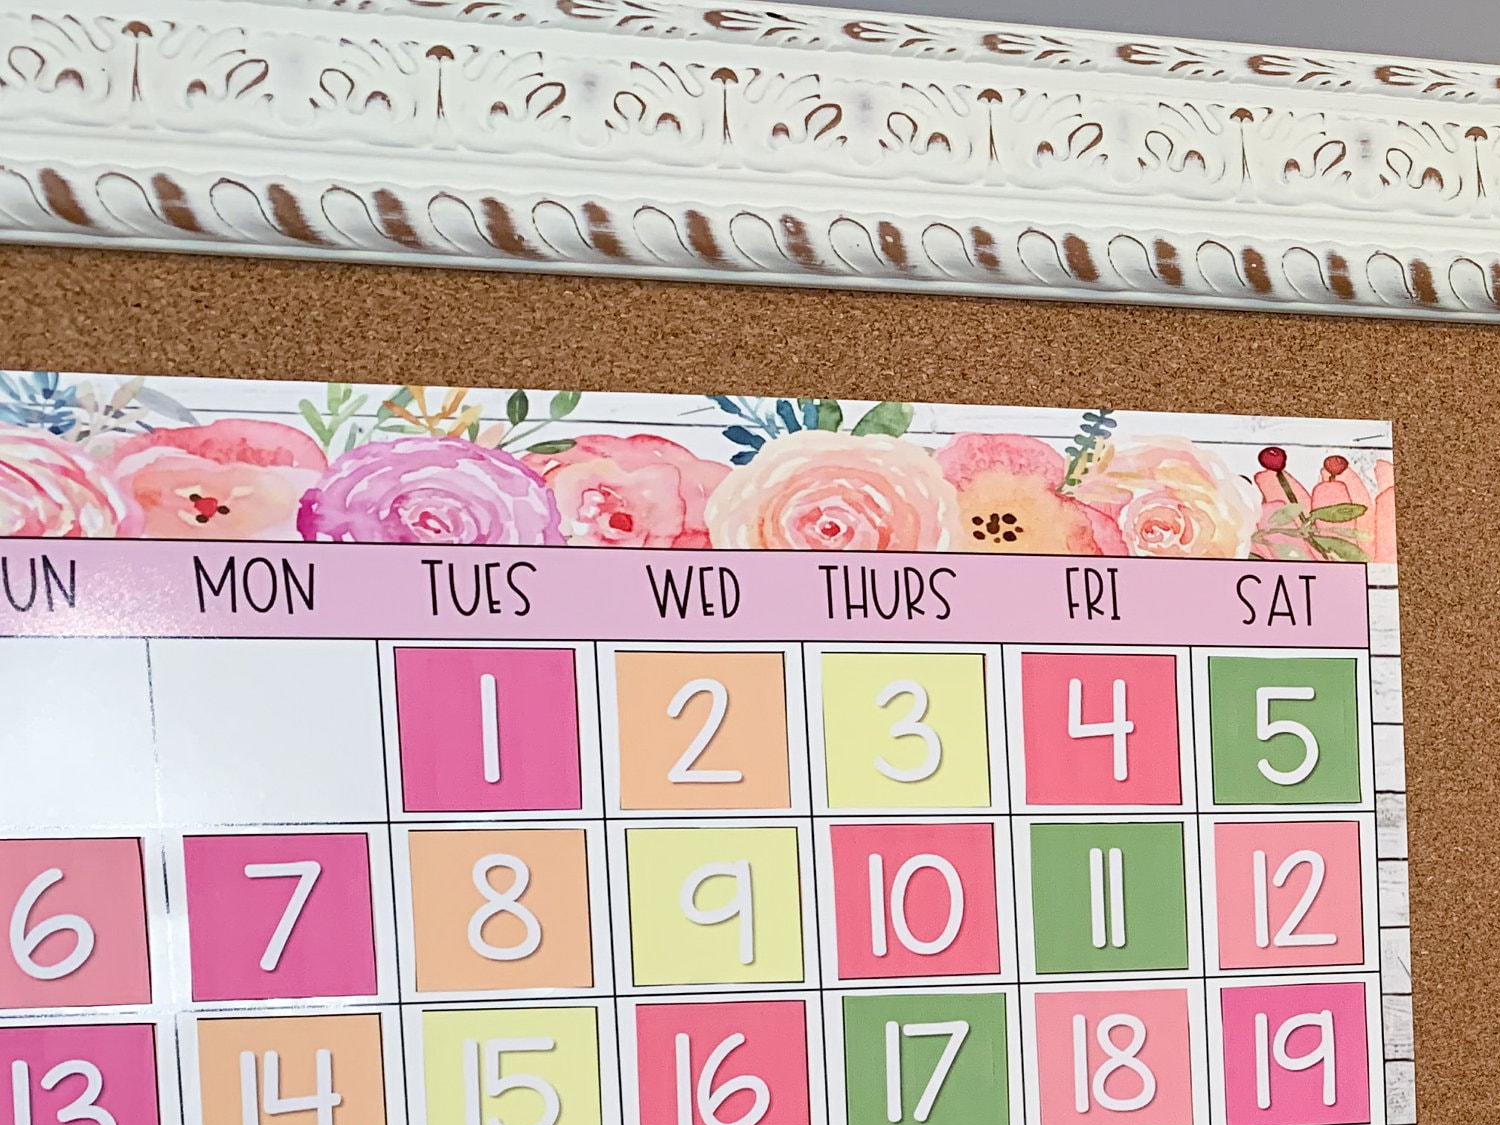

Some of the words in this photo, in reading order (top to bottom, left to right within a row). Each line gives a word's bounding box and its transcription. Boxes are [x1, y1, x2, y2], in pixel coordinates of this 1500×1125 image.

[194, 556, 315, 614] MON
[421, 559, 537, 616] TUES
[646, 564, 741, 620] WED
[819, 565, 957, 622] THURS
[1065, 567, 1122, 622] FRI
[1236, 574, 1317, 627] SAT
[480, 673, 501, 784] 1
[666, 678, 743, 783] 2
[873, 679, 942, 783] 3
[1068, 678, 1134, 782] 4
[1255, 686, 1319, 786] 5
[8, 868, 95, 981] 6
[243, 861, 323, 972] 7
[467, 852, 542, 961] 8
[679, 858, 754, 966] 9
[868, 853, 965, 957] 10
[1089, 847, 1126, 950] 11
[1253, 850, 1337, 950] 12
[885, 1019, 970, 1123] 17
[1072, 1013, 1157, 1114] 18
[1254, 1009, 1337, 1110] 19
